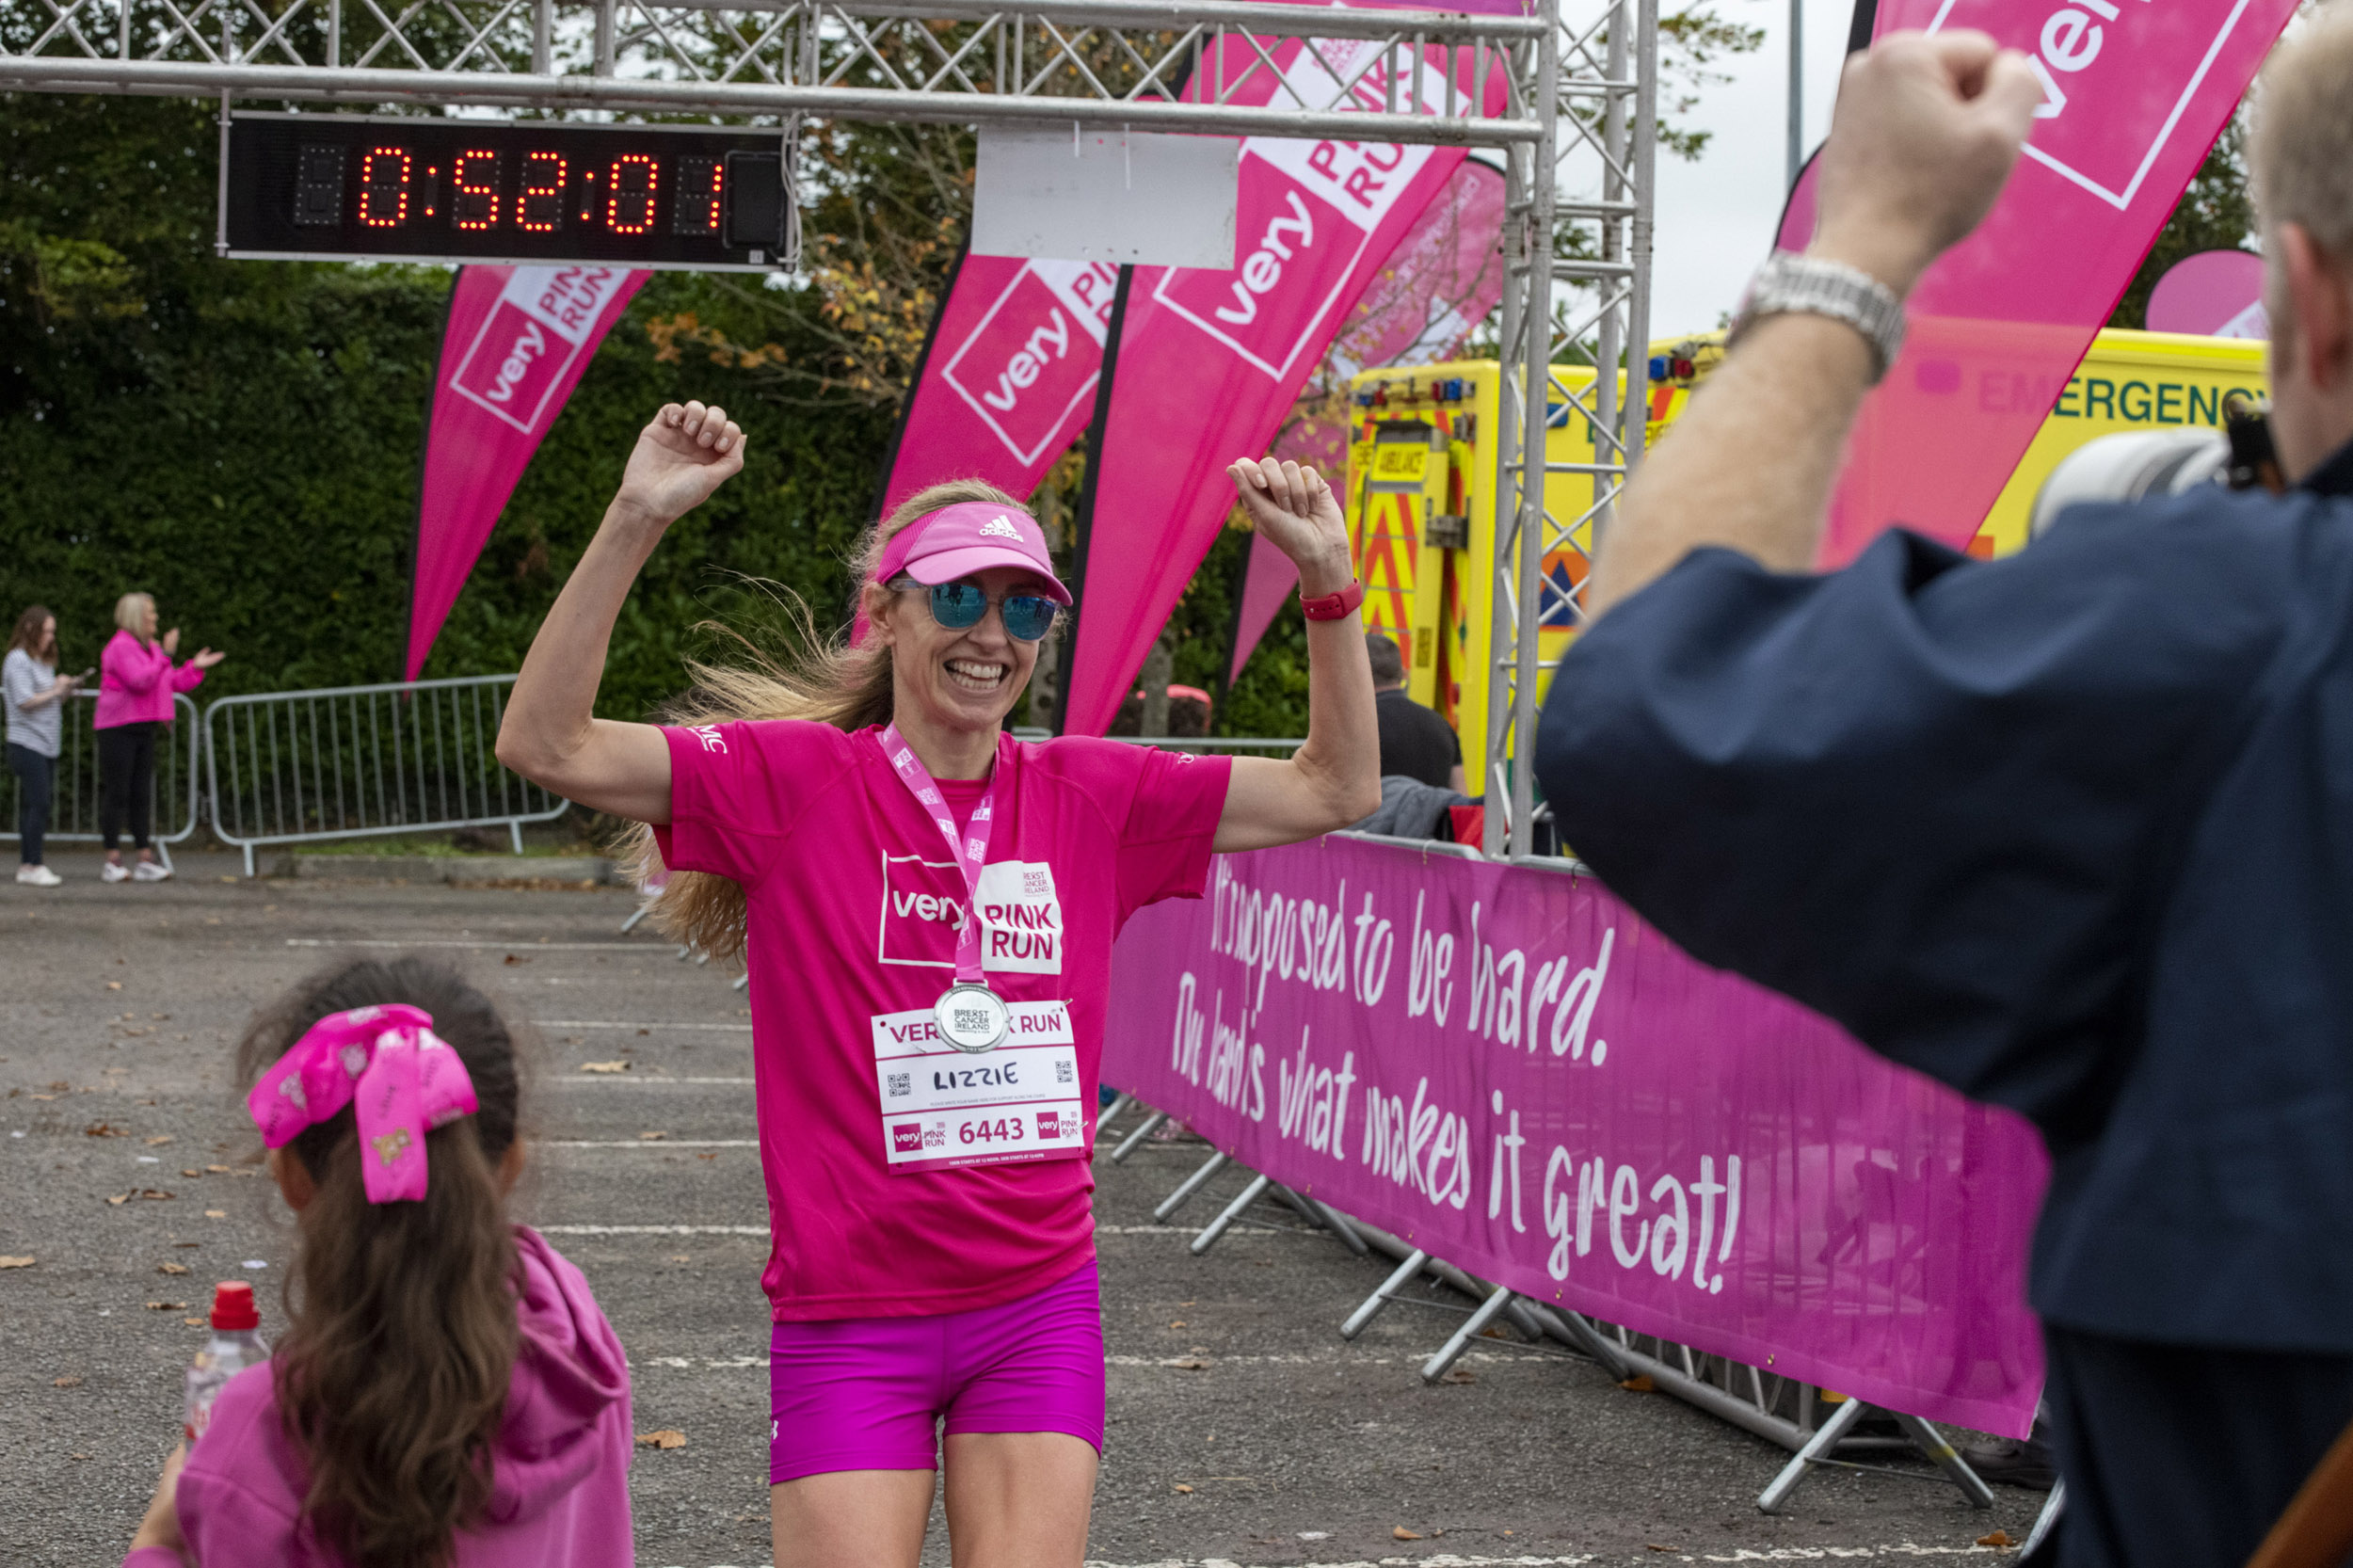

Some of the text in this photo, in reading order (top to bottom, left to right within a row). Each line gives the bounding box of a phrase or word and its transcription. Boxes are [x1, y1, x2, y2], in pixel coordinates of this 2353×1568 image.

[360, 147, 724, 233] 0:52:01
[1215, 191, 1313, 325] very
[486, 320, 546, 402] very
[984, 308, 1068, 411] very
[979, 527, 1024, 543] adidas
[984, 902, 1057, 930] PINK
[991, 929, 1053, 960] RUN
[1353, 891, 1394, 1006] to
[1407, 888, 1454, 1028] be
[1467, 901, 1614, 1066] hard.
[889, 1022, 942, 1044] VER
[1020, 1014, 1062, 1033] RUN
[954, 1016, 990, 1025] CANCER
[934, 1062, 1019, 1091] LIZZIE
[895, 1131, 920, 1144] very
[923, 1129, 947, 1140] PINK
[959, 1117, 1025, 1144] 6443
[1038, 1120, 1058, 1131] very
[1061, 1128, 1079, 1137] RUN
[924, 1138, 946, 1147] RUN
[1278, 1024, 1357, 1160] what
[1362, 1077, 1471, 1210] makes
[1489, 1090, 1527, 1233] it
[1544, 1145, 1741, 1295] great!
